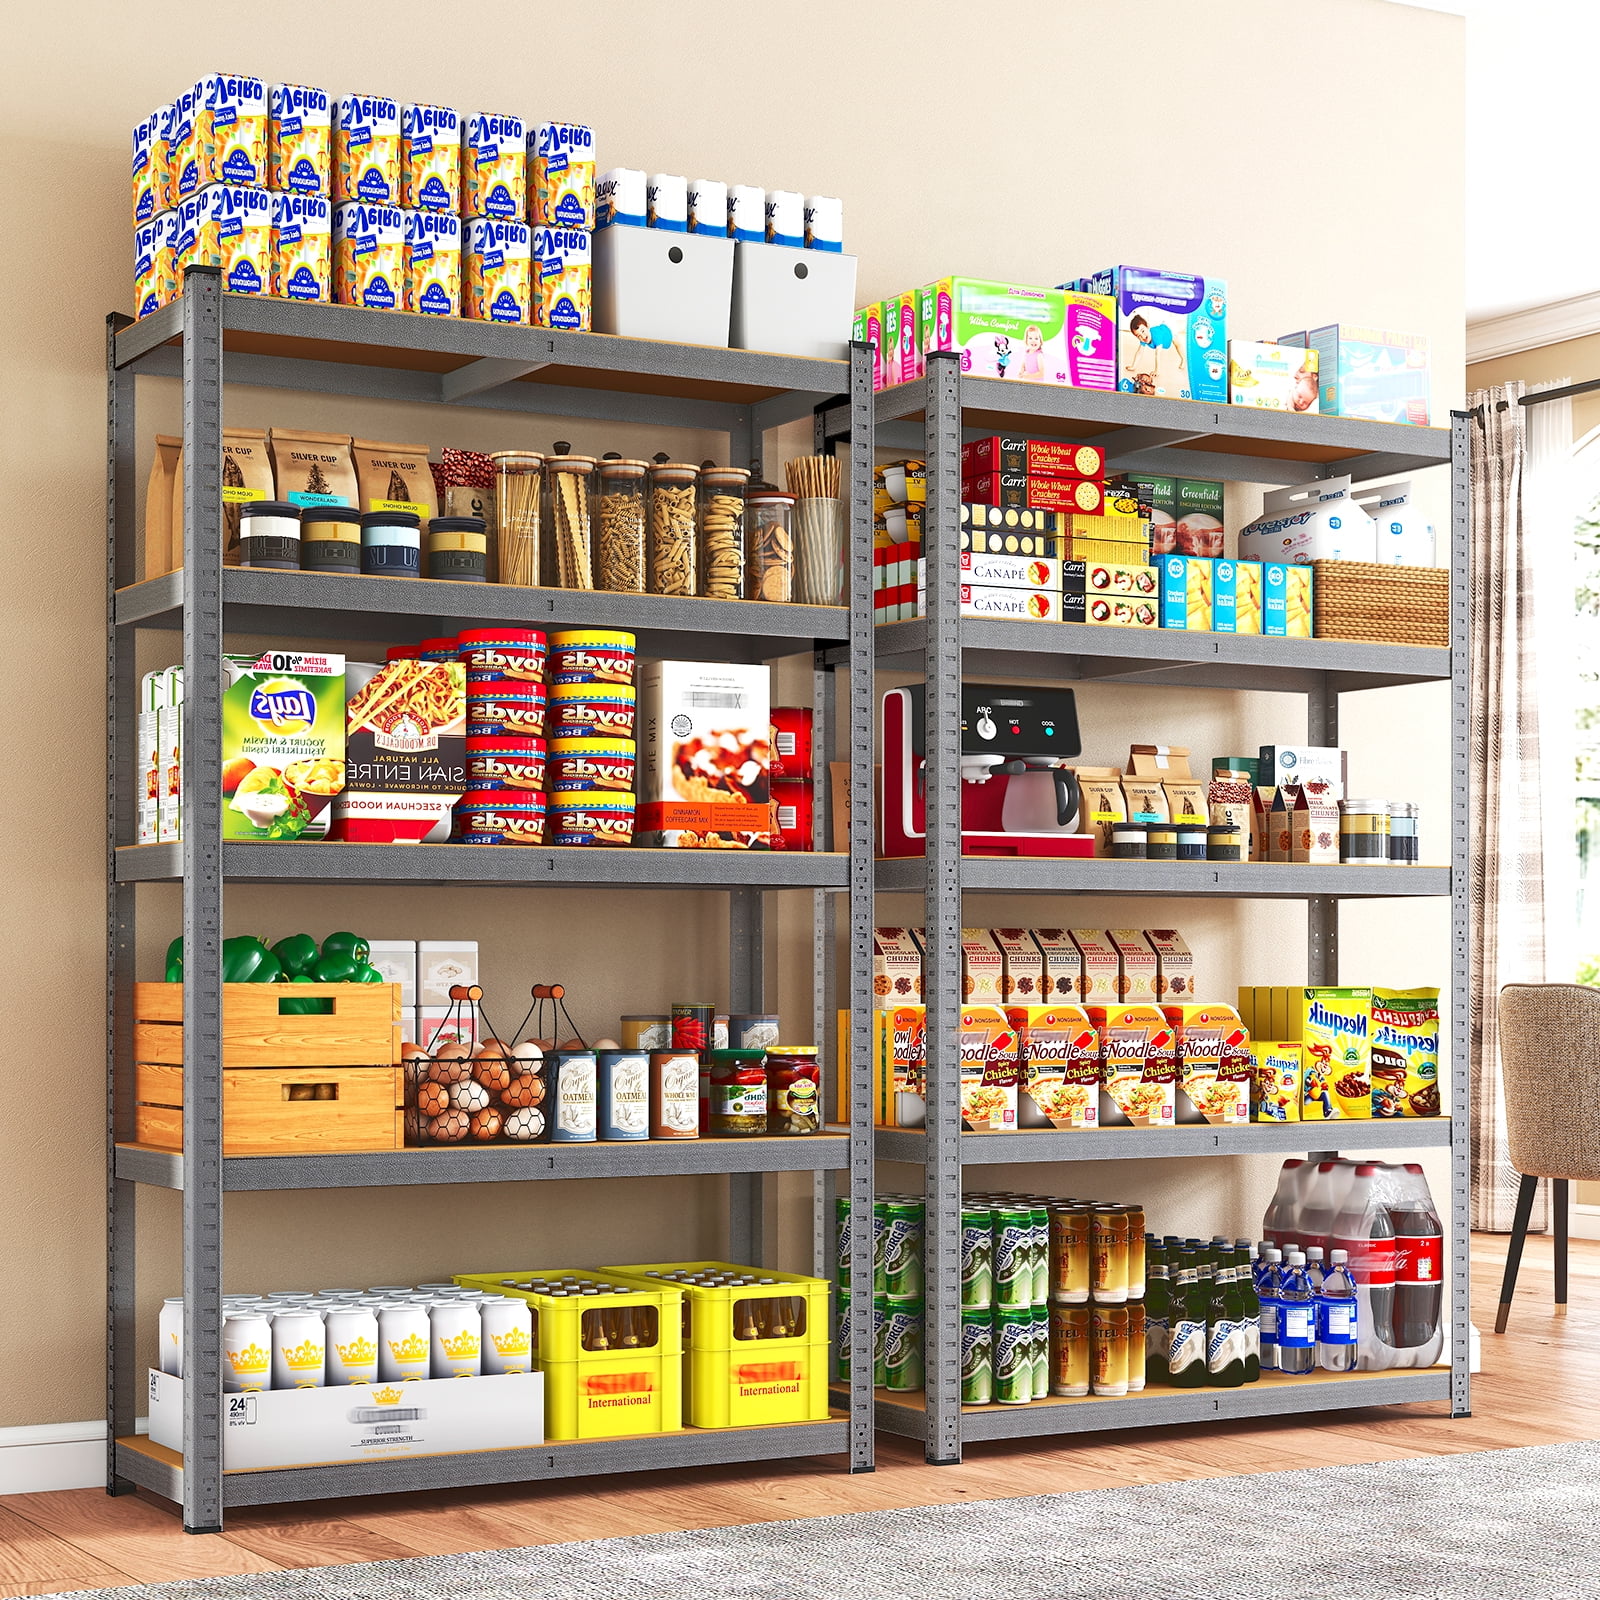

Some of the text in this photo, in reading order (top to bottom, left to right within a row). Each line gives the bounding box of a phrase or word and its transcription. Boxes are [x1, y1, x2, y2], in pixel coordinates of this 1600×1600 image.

[989, 318, 1020, 333] Comfort
[961, 357, 969, 367] 5
[1056, 371, 1066, 380] 64
[1121, 381, 1129, 391] 6
[1180, 389, 1191, 399] 30
[1001, 438, 1027, 452] Carr's
[1030, 444, 1071, 456] Whole Wheat
[235, 447, 252, 456] CUP
[290, 452, 337, 463] SILVER CUP
[1030, 453, 1060, 463] Crackers
[371, 459, 416, 470] SILVER CUP
[1001, 474, 1027, 488] Carr's
[1030, 480, 1071, 491] Whole Wheat
[300, 495, 338, 503] WONDERLAND
[1030, 489, 1060, 499] Crackers
[1181, 486, 1220, 501] Greenfield
[974, 564, 1025, 580] CANAPÉ
[1063, 561, 1085, 572] Carr's
[1063, 593, 1085, 604] Carr's
[974, 597, 1025, 613] CANAPÉ
[976, 706, 992, 714] ABC
[648, 717, 656, 772] PIE MIX
[665, 816, 708, 824] COFFEECAKE MIX
[961, 1045, 998, 1061] oodle
[1029, 1043, 1079, 1060] Noodle
[1107, 1043, 1157, 1059] Noodle
[1184, 1043, 1232, 1057] Noodle
[985, 1067, 1018, 1081] Chicke
[1067, 1065, 1099, 1079] Chicke
[1144, 1064, 1175, 1077] Chicke
[1220, 1063, 1250, 1075] Chicke
[739, 1382, 800, 1398] International
[229, 1397, 246, 1412] 24
[588, 1394, 651, 1409] International
[360, 1435, 414, 1446] SUPERIOR STRENGTH
